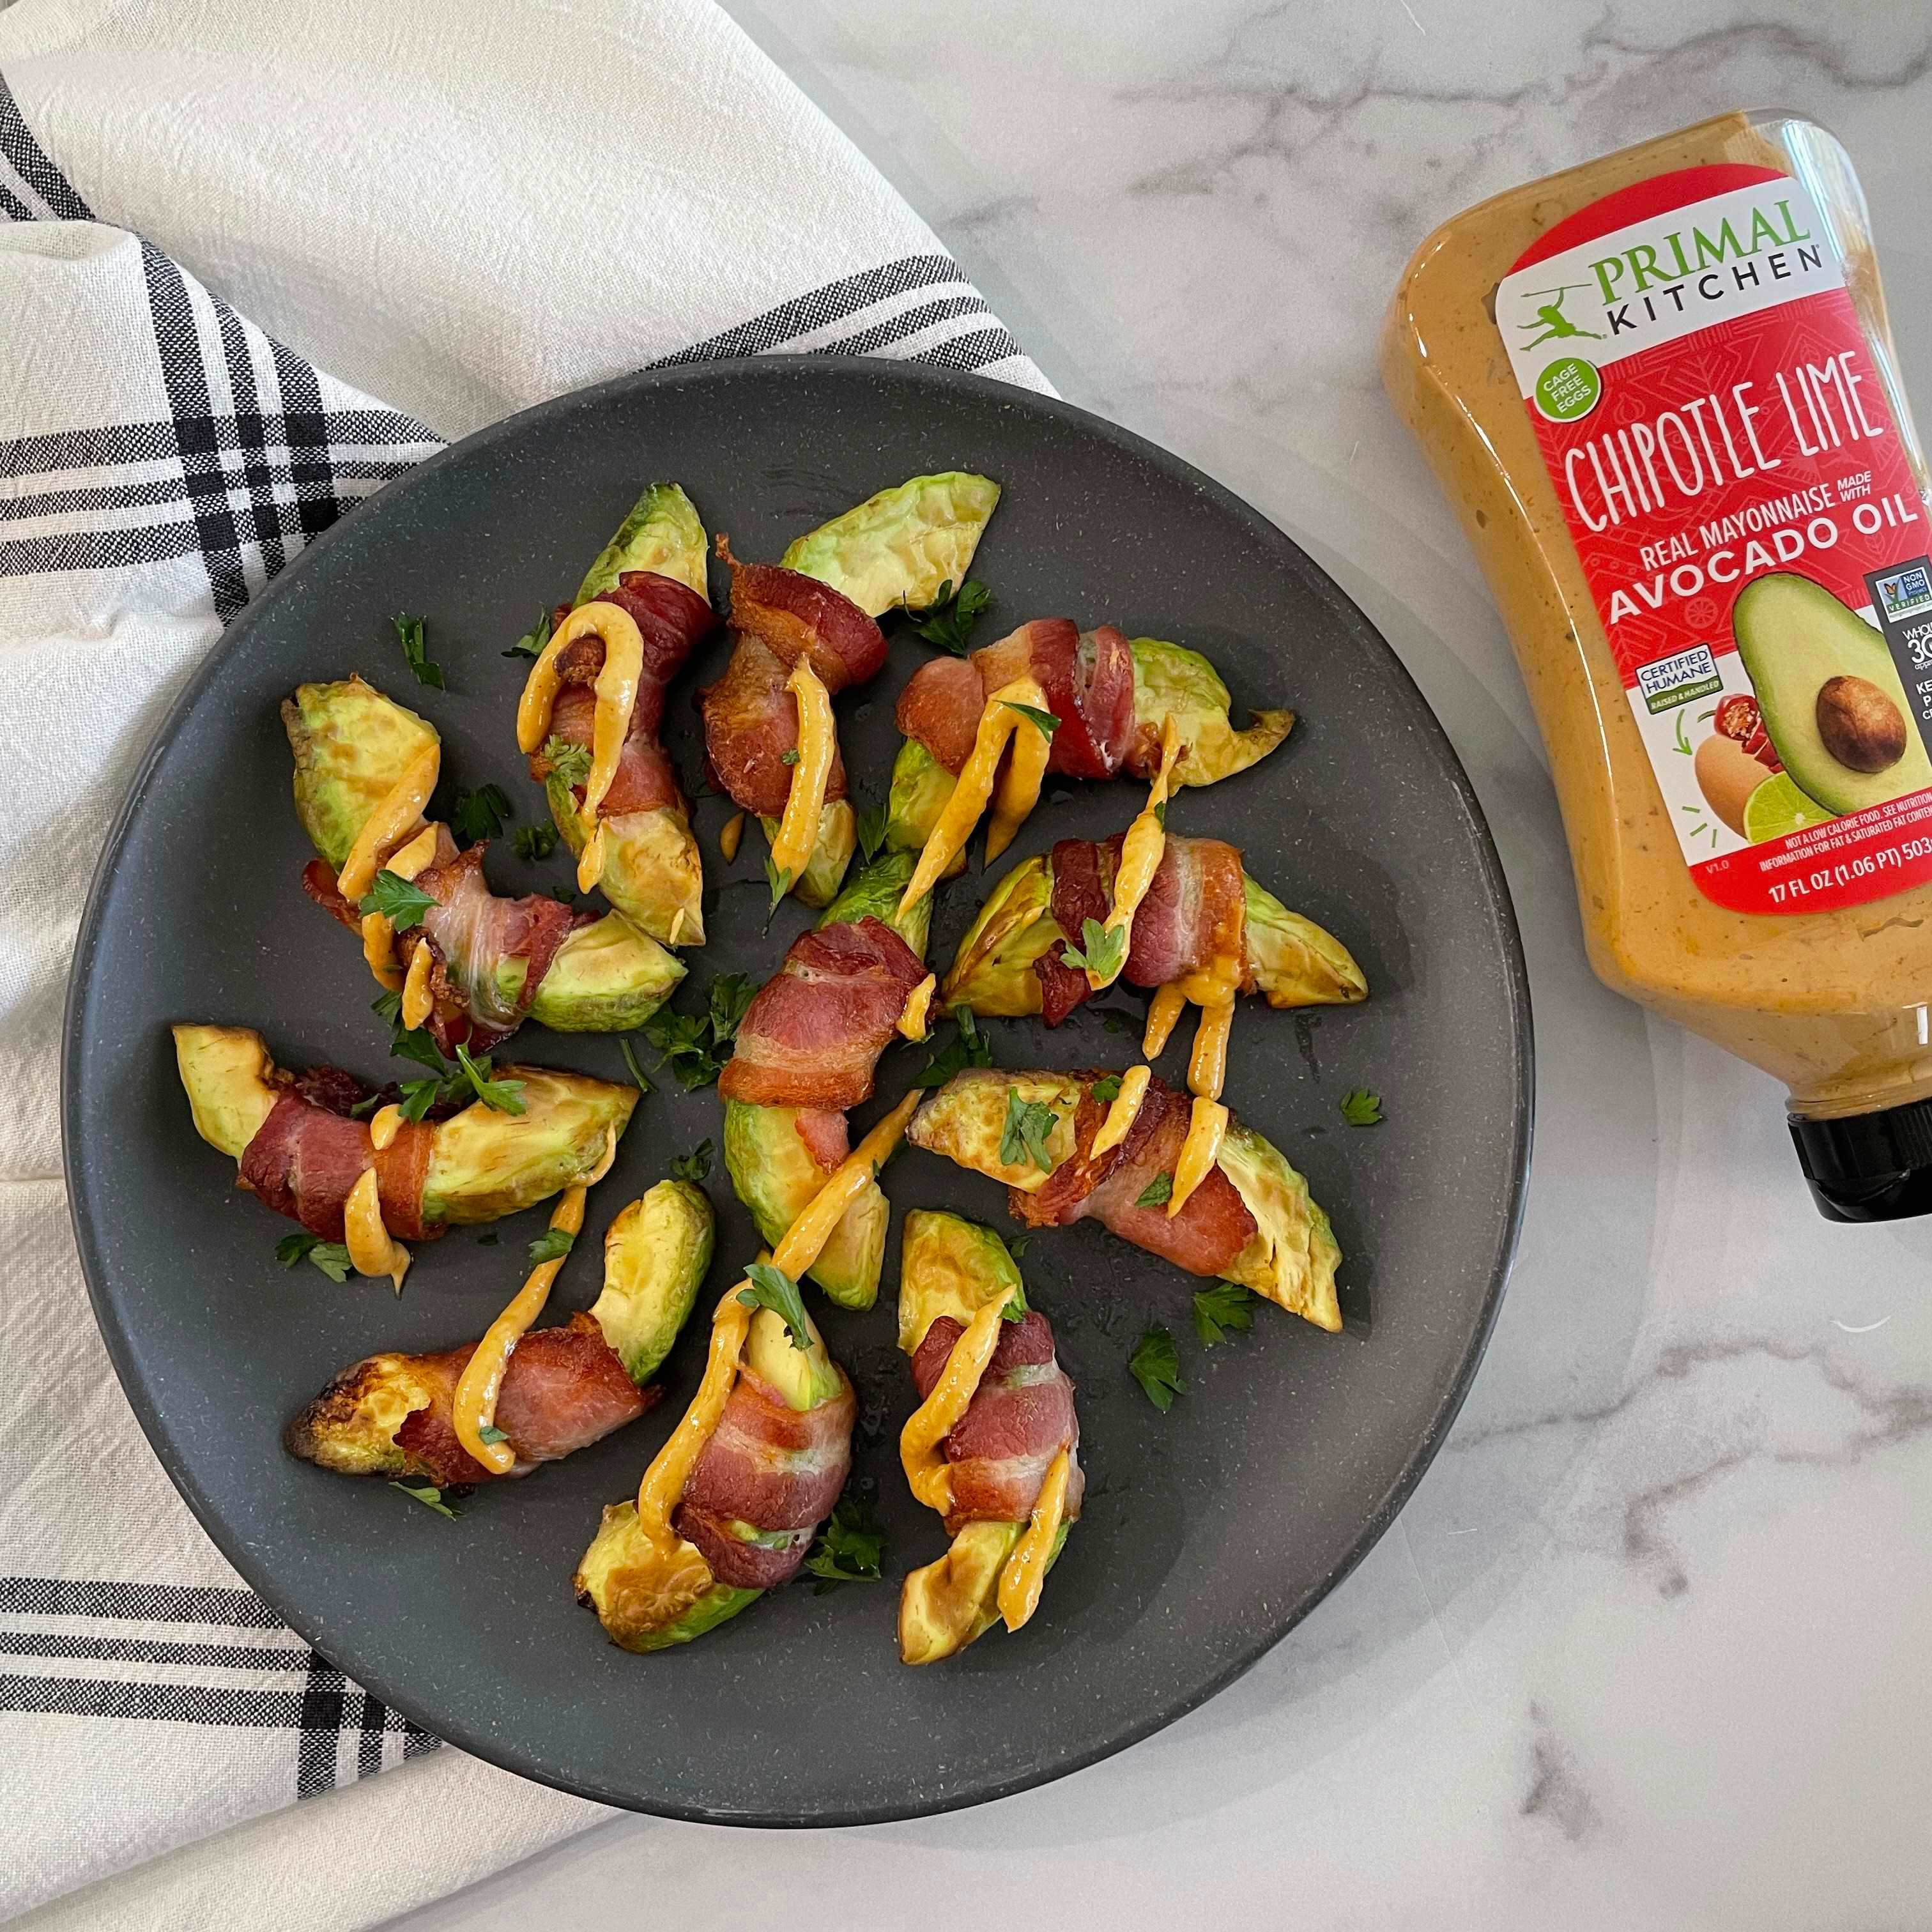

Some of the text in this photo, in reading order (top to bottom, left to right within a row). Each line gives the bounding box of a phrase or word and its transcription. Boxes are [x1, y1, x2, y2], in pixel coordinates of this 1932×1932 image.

[1588, 200, 1811, 306] PRIMAL
[1607, 245, 1822, 335] KITCHEN
[1544, 363, 1578, 391] CAGE
[1551, 375, 1583, 401] FREE
[1556, 385, 1591, 413] EGGS
[1565, 351, 1883, 532] CHIPOTLE LIME
[1837, 470, 1871, 490] MADE
[1839, 484, 1871, 503] WITH
[1640, 483, 1836, 571] REAL MAYONNAISE
[1610, 493, 1918, 624] AVOCADO OIL
[1903, 572, 1922, 583] NON
[1906, 579, 1925, 590] GMO
[1889, 594, 1930, 611] VERIFIED
[1641, 650, 1708, 681] CERTIFIED
[1646, 662, 1712, 693] HUMANE
[1651, 695, 1678, 710] RAISED
[1684, 680, 1719, 698] HANDLED
[1785, 792, 1932, 849] NOT A LOW CALORIE FOOD. SEE NUTRITION
[1759, 846, 1813, 871] INFORMATION
[1813, 841, 1830, 854] FOR
[1830, 835, 1844, 849] FAT
[1844, 833, 1852, 844] &
[1851, 820, 1893, 842] SATURATED
[1892, 815, 1906, 828] FAT
[1706, 860, 1729, 874] V1.0
[1768, 837, 1932, 903] 17 FL OZ (1.06 PT) 503
